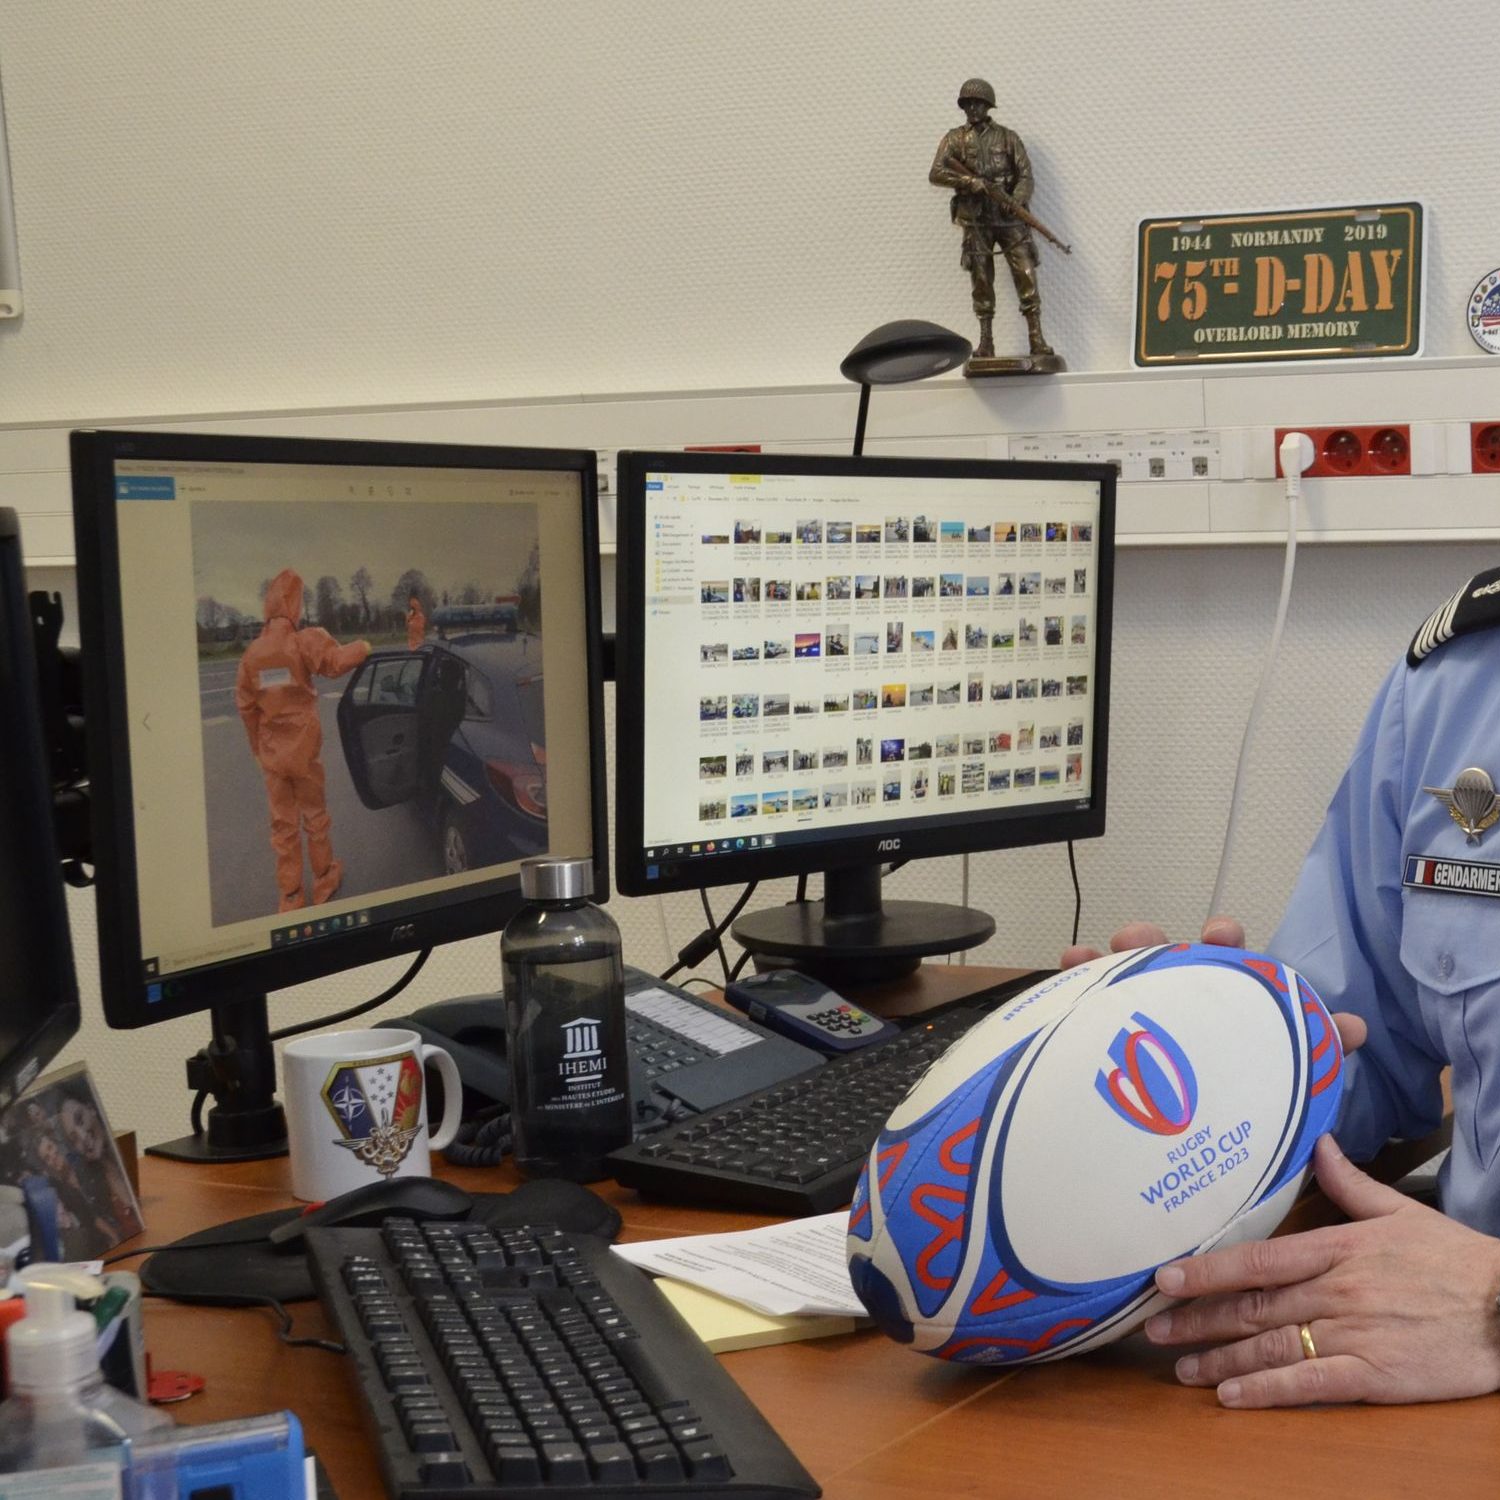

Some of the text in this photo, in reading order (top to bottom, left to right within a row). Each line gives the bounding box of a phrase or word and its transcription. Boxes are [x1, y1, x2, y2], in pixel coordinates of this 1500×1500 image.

[1171, 224, 1387, 251] 1944 NORMANDY 2019
[1253, 249, 1402, 317] D-DAY
[1193, 320, 1360, 344] OVERLORD MEMORY
[878, 838, 900, 850] AOC
[558, 1057, 608, 1076] IHEMI
[568, 1081, 602, 1092] INSTITUT
[1166, 1125, 1213, 1164] RUGBY
[1140, 1120, 1252, 1205] WORLD CUP
[1163, 1147, 1250, 1213] FRANCE 2023
